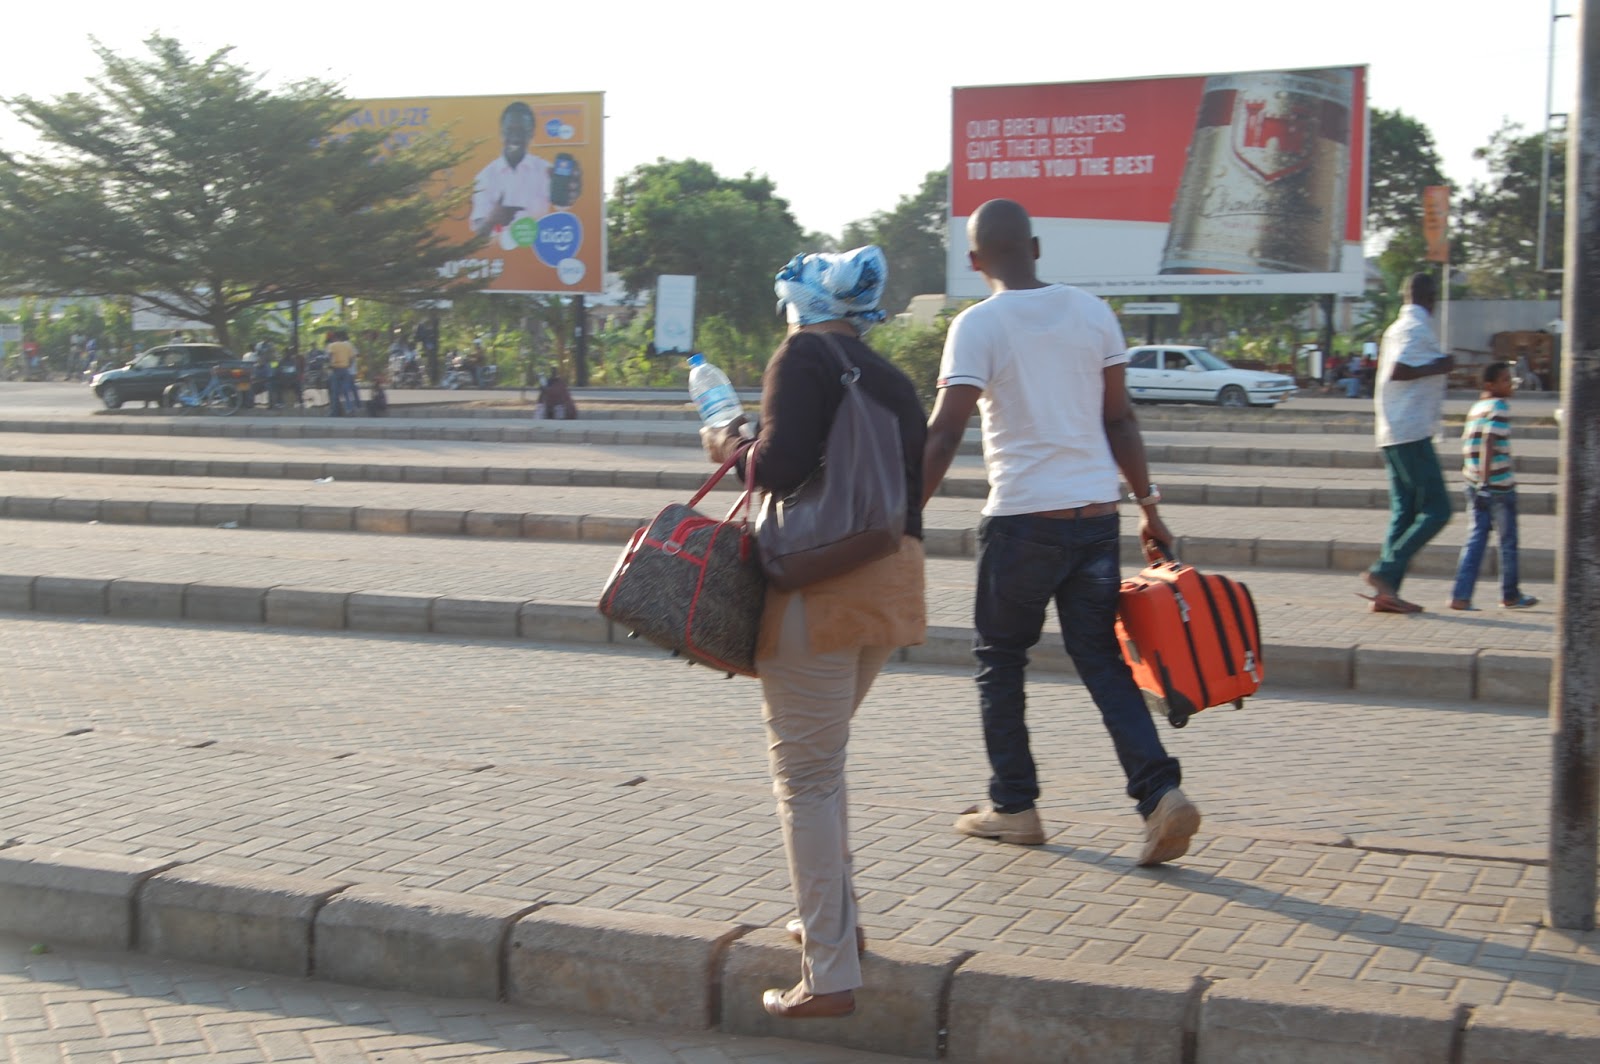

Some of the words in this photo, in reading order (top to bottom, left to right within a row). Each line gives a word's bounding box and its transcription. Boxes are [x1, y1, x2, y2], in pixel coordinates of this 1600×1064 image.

[966, 119, 1000, 139] OUR
[1003, 117, 1049, 137] BREW
[1052, 113, 1127, 134] MASTERS
[966, 140, 1002, 159] GIVE
[1006, 138, 1051, 157] THEIR
[1054, 136, 1096, 156] BEST
[965, 161, 988, 180] TO
[990, 159, 1041, 179] BRING
[1043, 158, 1077, 177] YOU
[1079, 156, 1111, 176] THE
[1113, 154, 1156, 175] BEST
[540, 226, 574, 251] tigo
